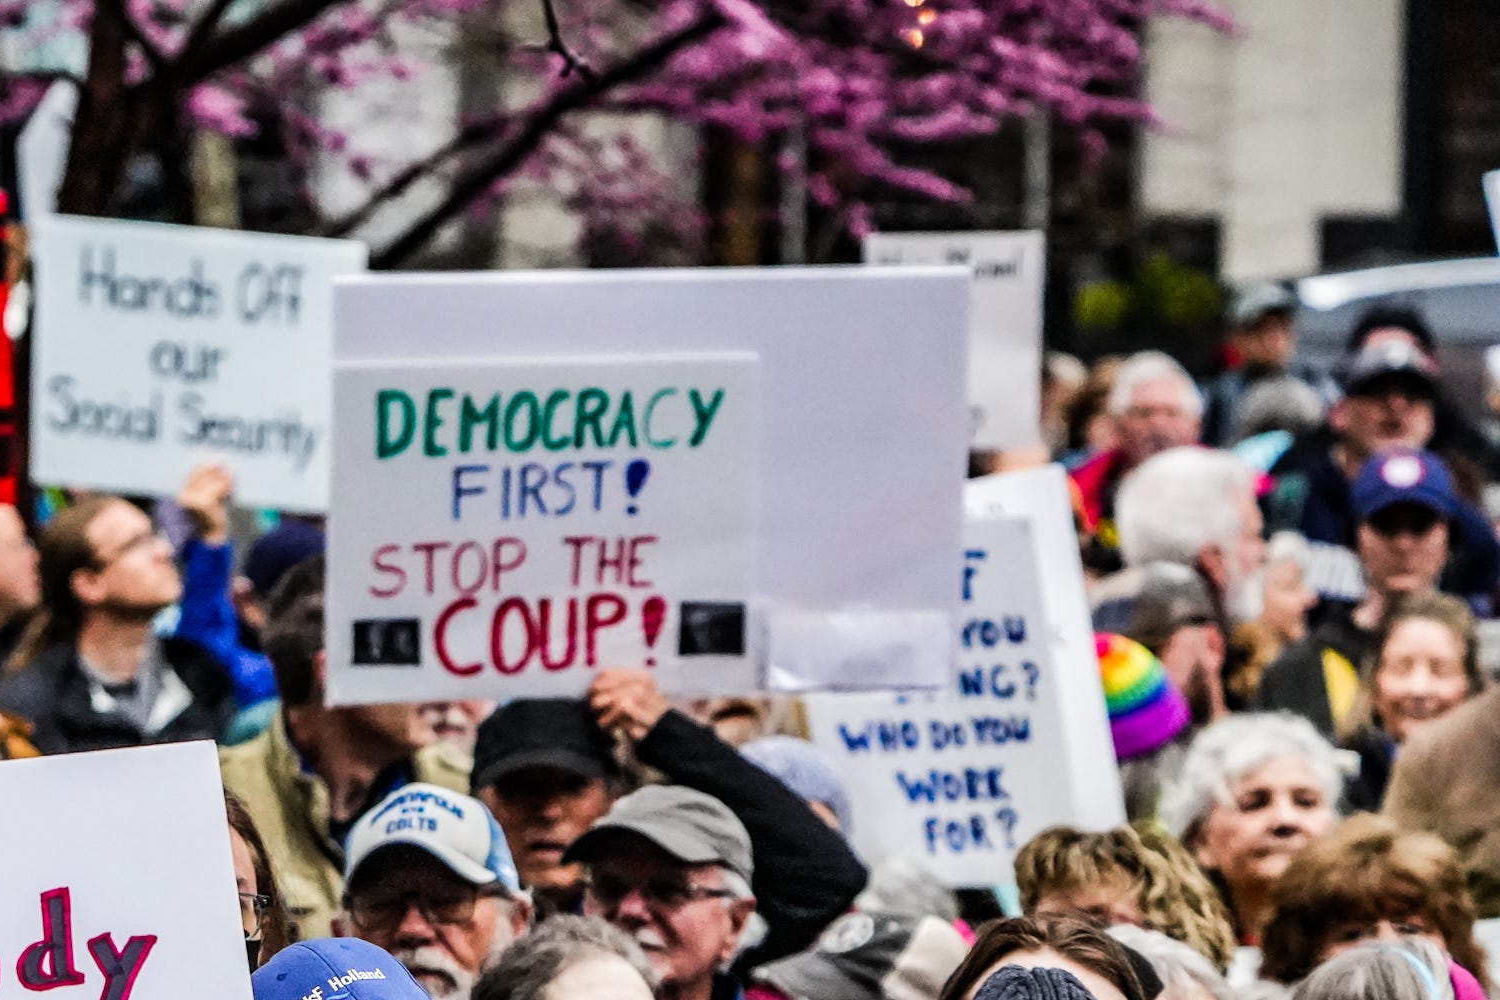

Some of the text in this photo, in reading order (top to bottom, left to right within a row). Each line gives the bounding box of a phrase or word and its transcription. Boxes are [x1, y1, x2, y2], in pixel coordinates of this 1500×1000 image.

[76, 243, 220, 318] Hands
[47, 372, 164, 442] Social
[375, 386, 726, 459] DEMOCRACY
[450, 458, 651, 522] FIRST!
[368, 534, 660, 600] STOP THE
[433, 592, 669, 678] COUP!
[837, 715, 1033, 752] WHO DO YOU
[895, 766, 1011, 803] WORK
[385, 815, 438, 836] COLTS
[923, 806, 1020, 855] FOR?
[327, 967, 387, 993] Holland
